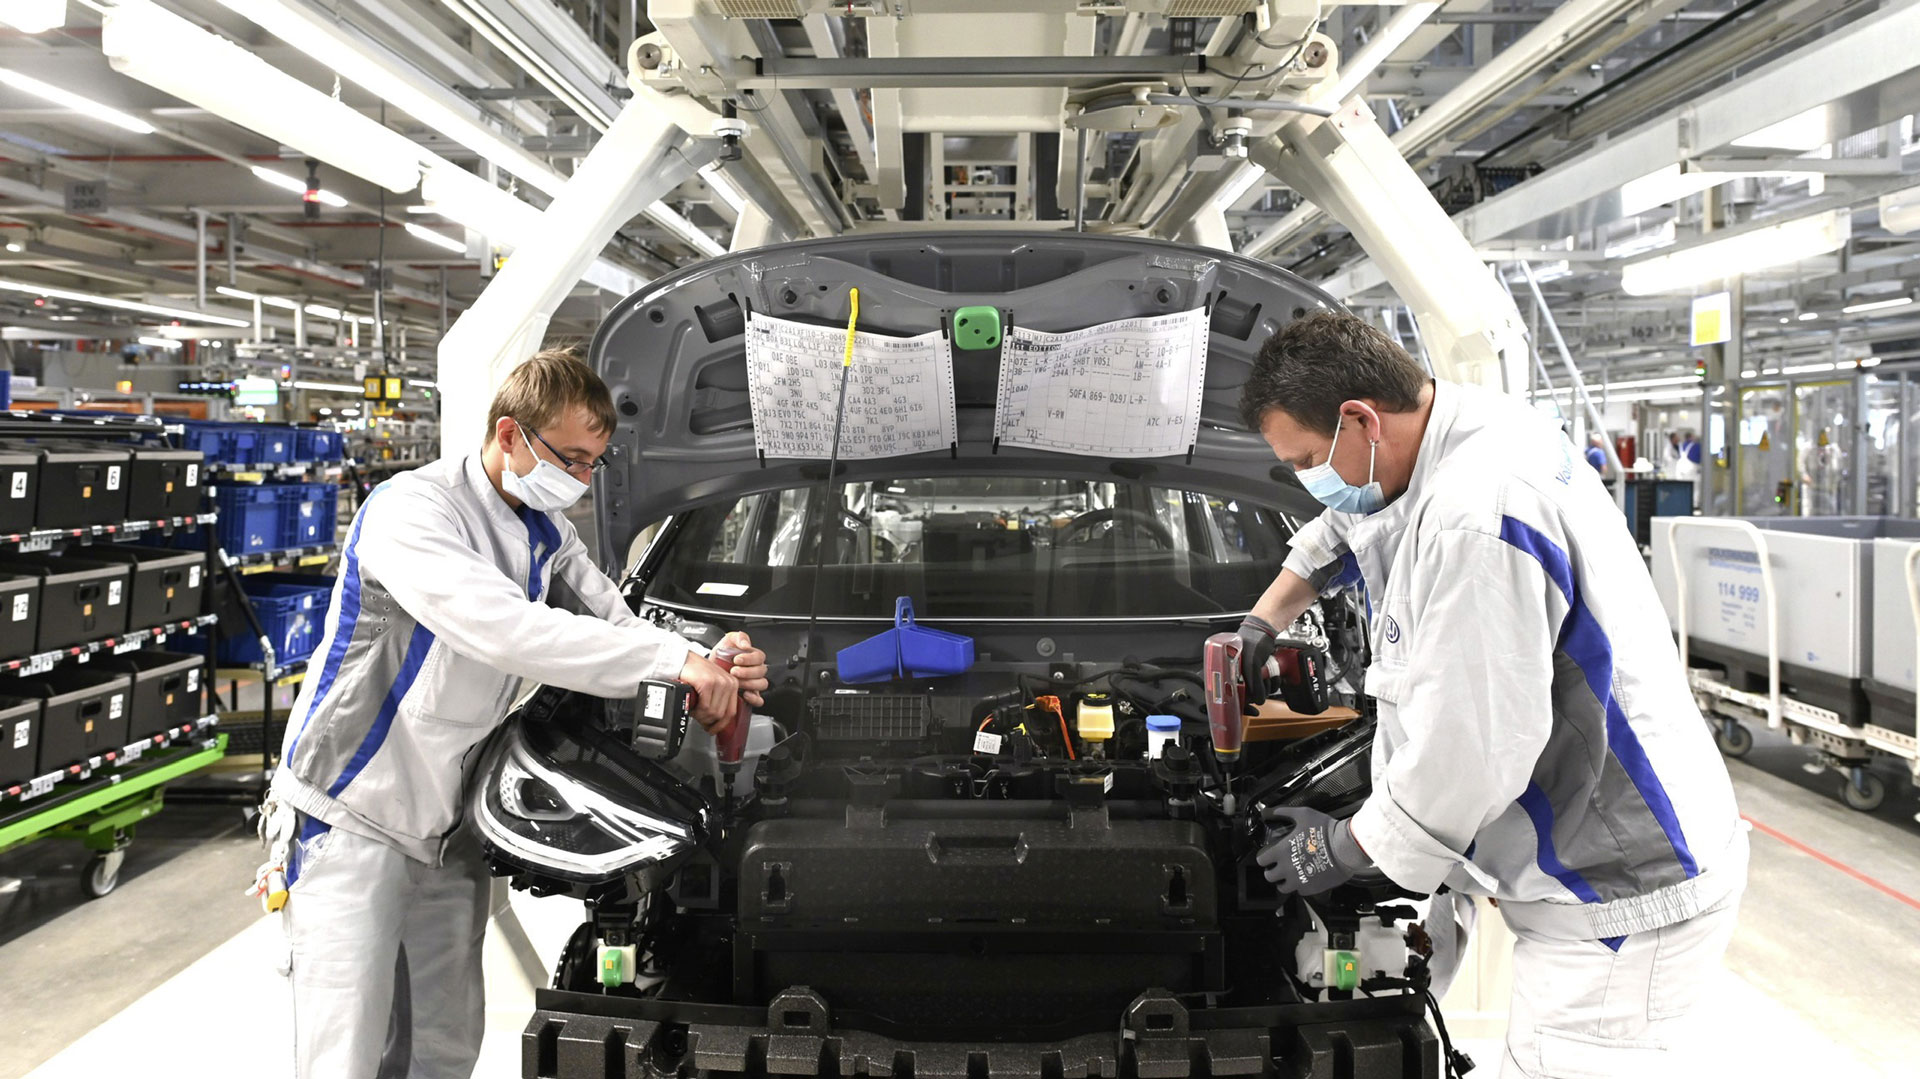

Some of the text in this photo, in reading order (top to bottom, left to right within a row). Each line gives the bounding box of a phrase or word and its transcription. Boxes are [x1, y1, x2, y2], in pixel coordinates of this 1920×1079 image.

[16, 478, 24, 493] 4
[110, 470, 118, 486] 6
[1718, 581, 1760, 603] 114 999
[14, 600, 28, 614] 12
[1288, 838, 1309, 884] MaxiFlex
